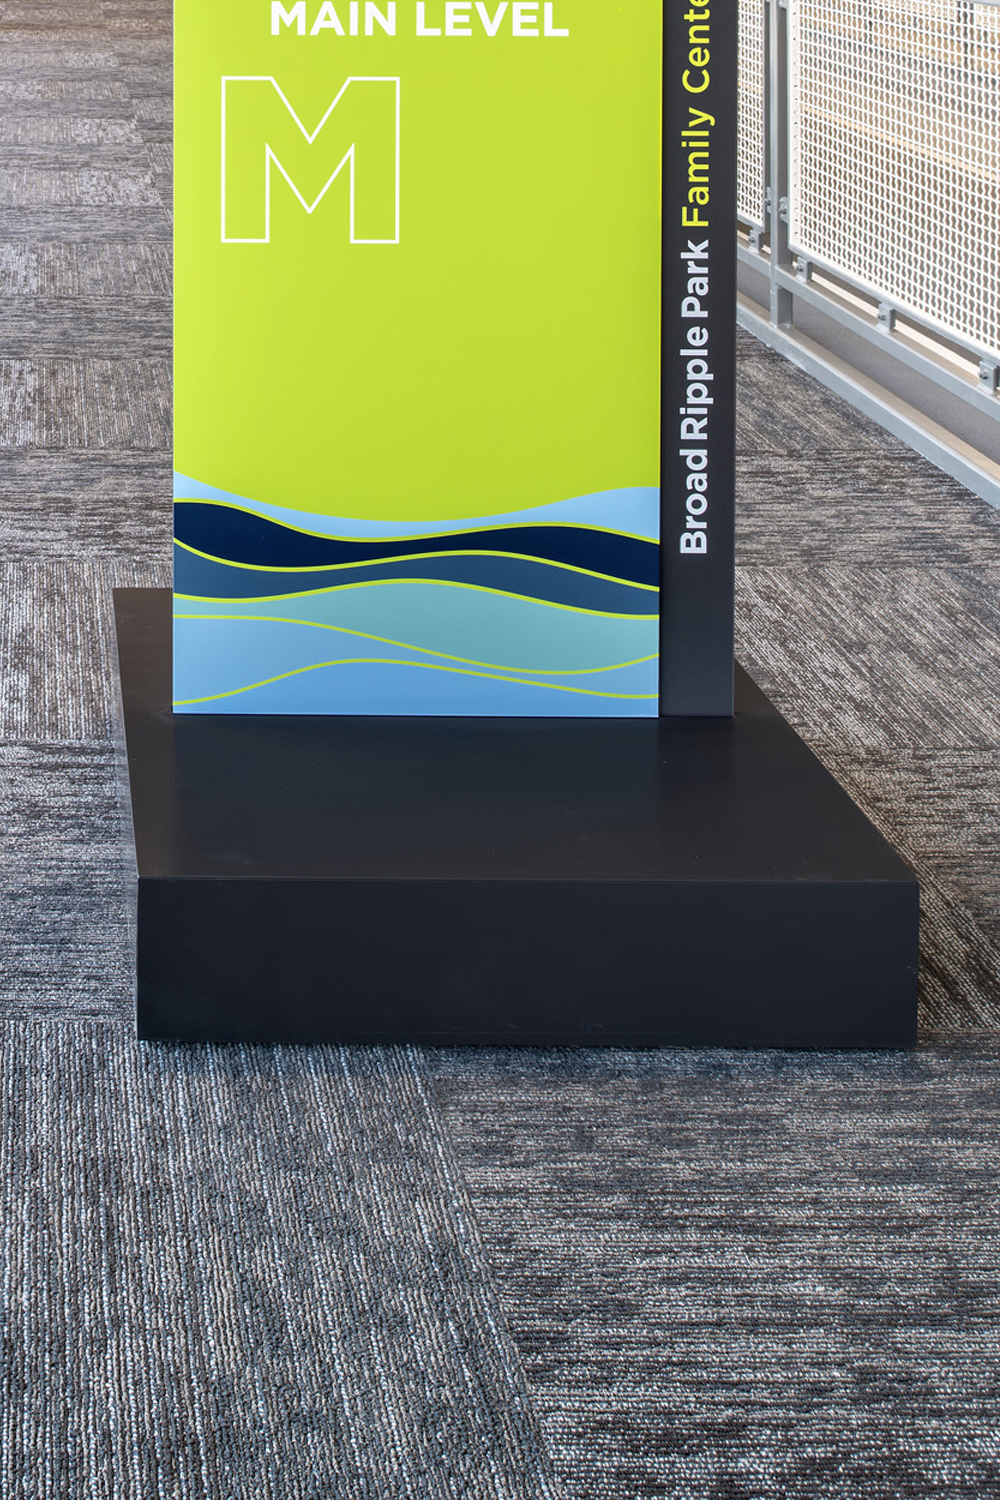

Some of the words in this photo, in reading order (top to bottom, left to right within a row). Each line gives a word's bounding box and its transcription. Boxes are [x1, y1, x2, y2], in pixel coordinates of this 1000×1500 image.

[271, 1, 396, 36] MAIN
[416, 1, 569, 37] LEVEL
[221, 76, 400, 244] M
[681, 108, 715, 226] Family
[681, 240, 708, 317] Park
[680, 327, 713, 439] Ripple
[680, 449, 707, 553] Broad
